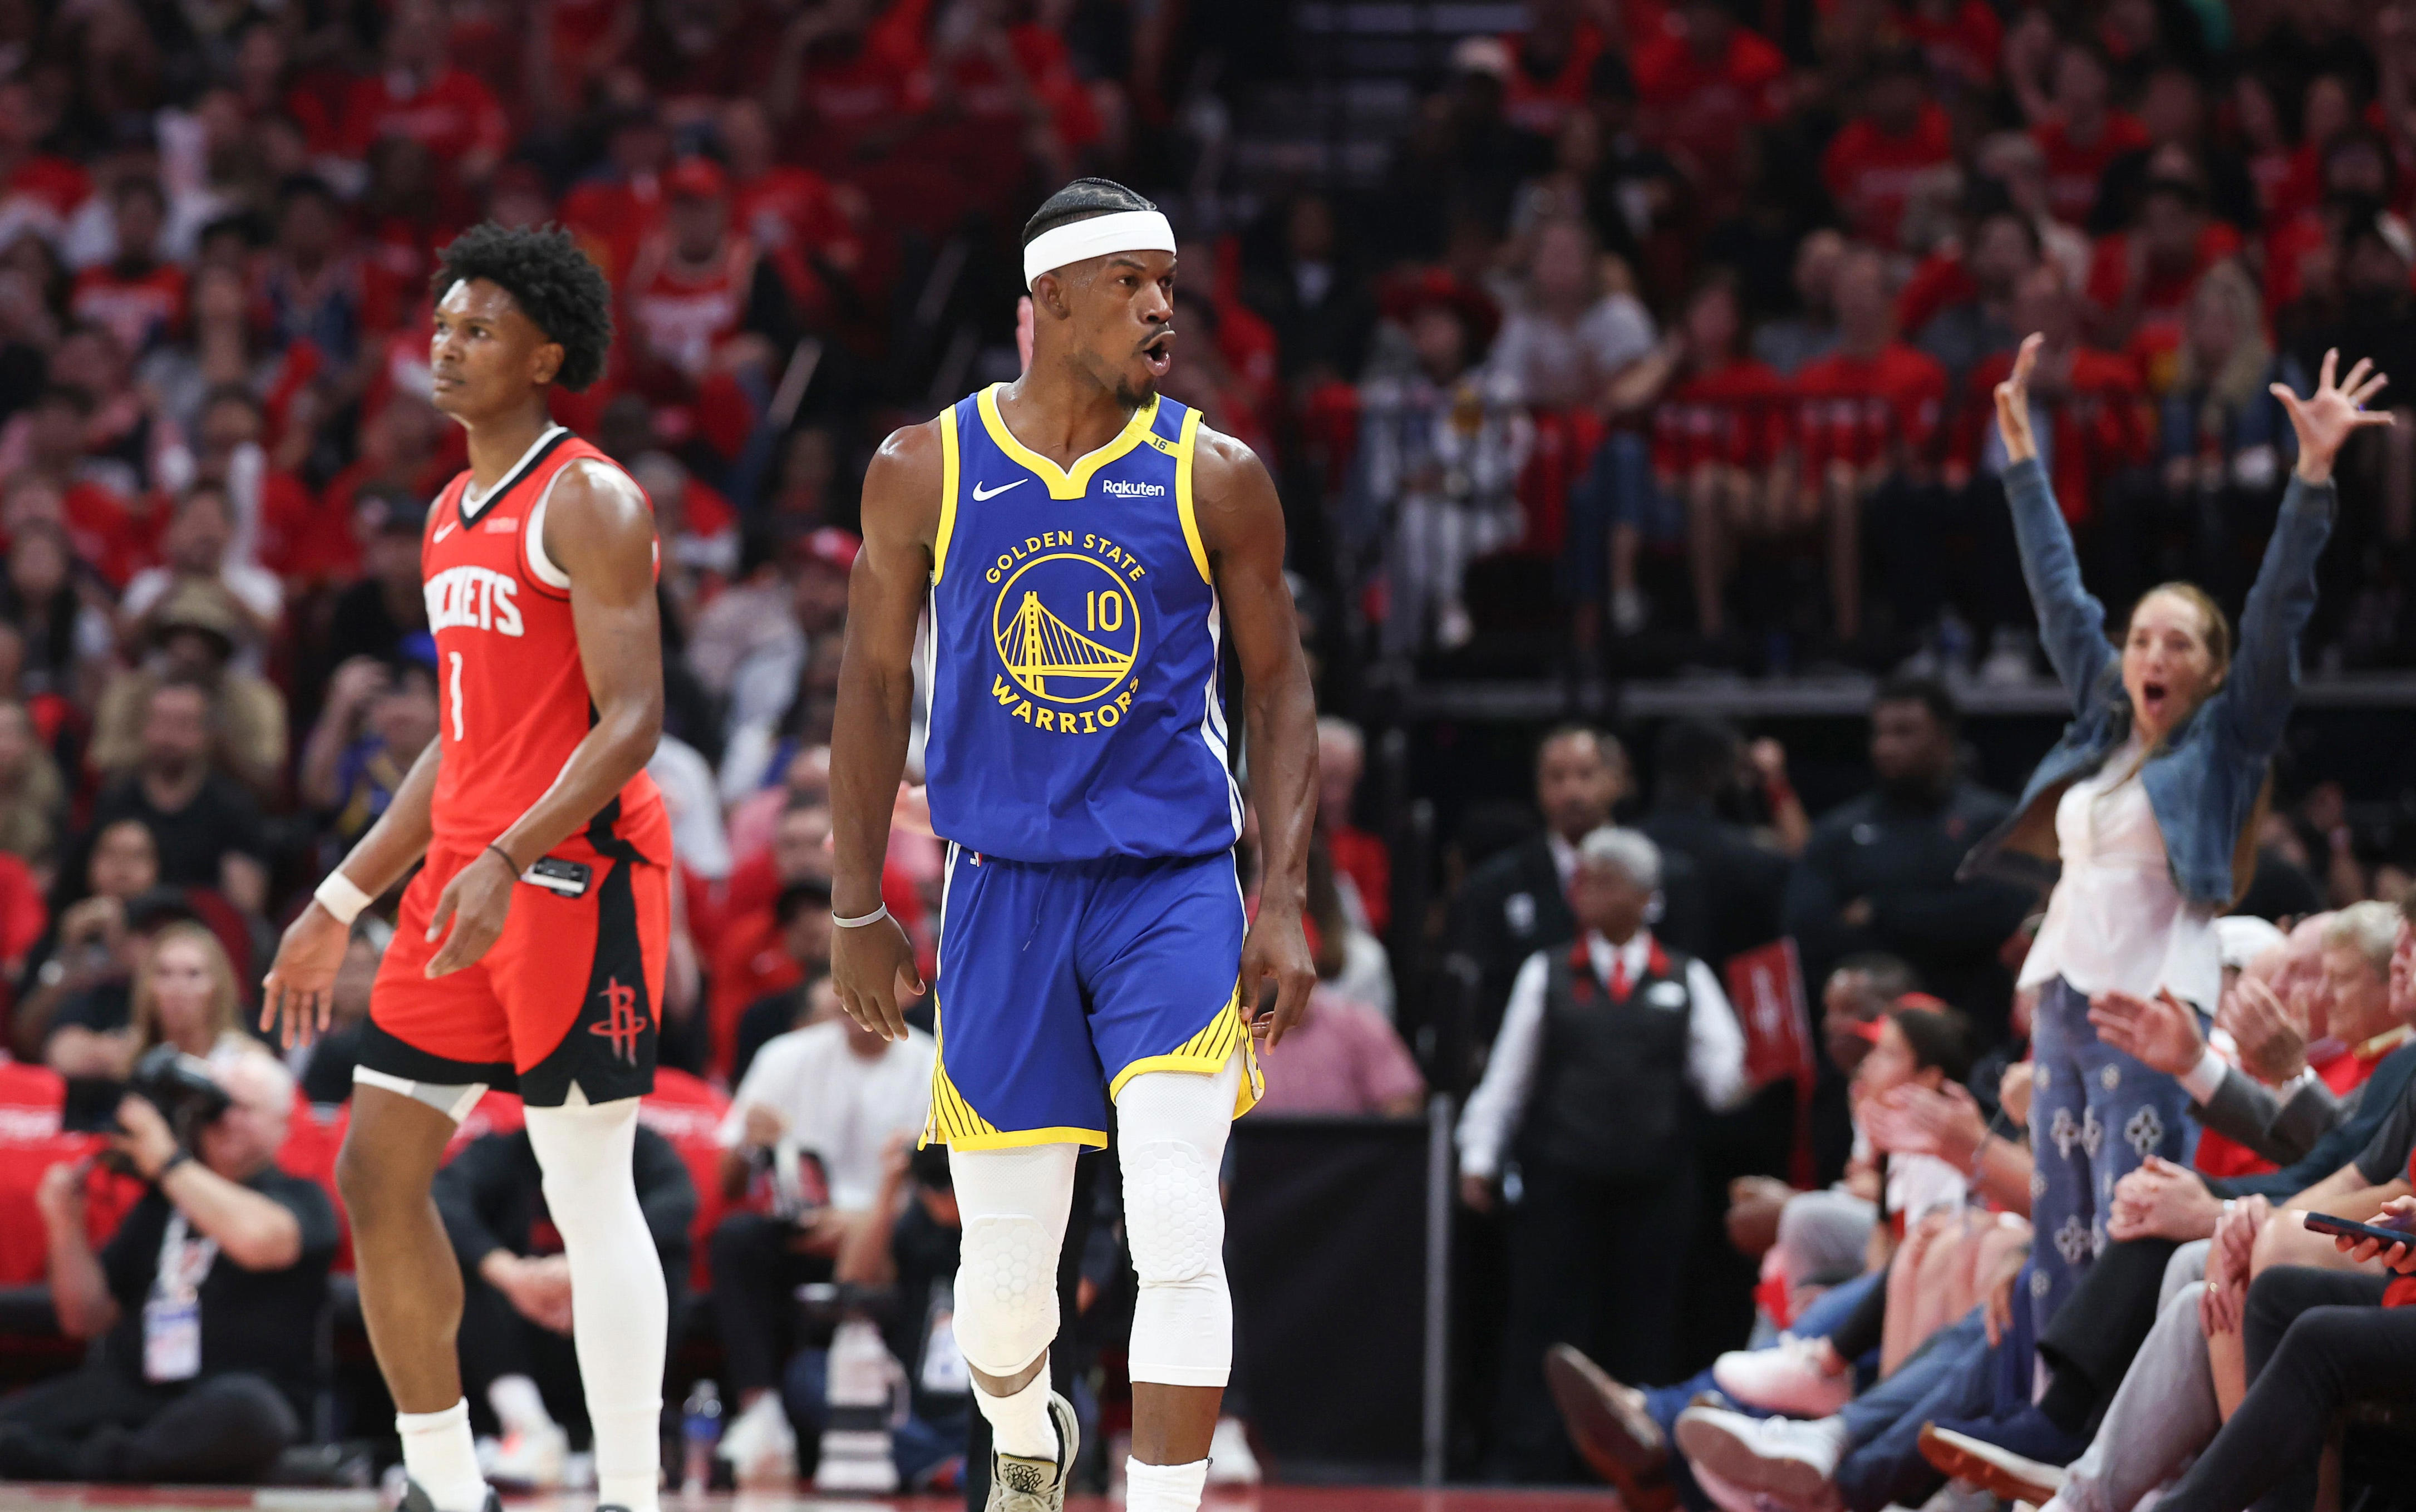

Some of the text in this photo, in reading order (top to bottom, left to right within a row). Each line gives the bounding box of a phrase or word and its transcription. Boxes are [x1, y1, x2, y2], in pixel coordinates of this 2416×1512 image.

[1153, 437, 1168, 450] 16
[1103, 479, 1165, 498] Rakuten
[986, 530, 1146, 583] GOLDEN STATE
[1086, 590, 1123, 632] 10
[448, 651, 464, 742] 1
[991, 673, 1139, 734] WARRIORS
